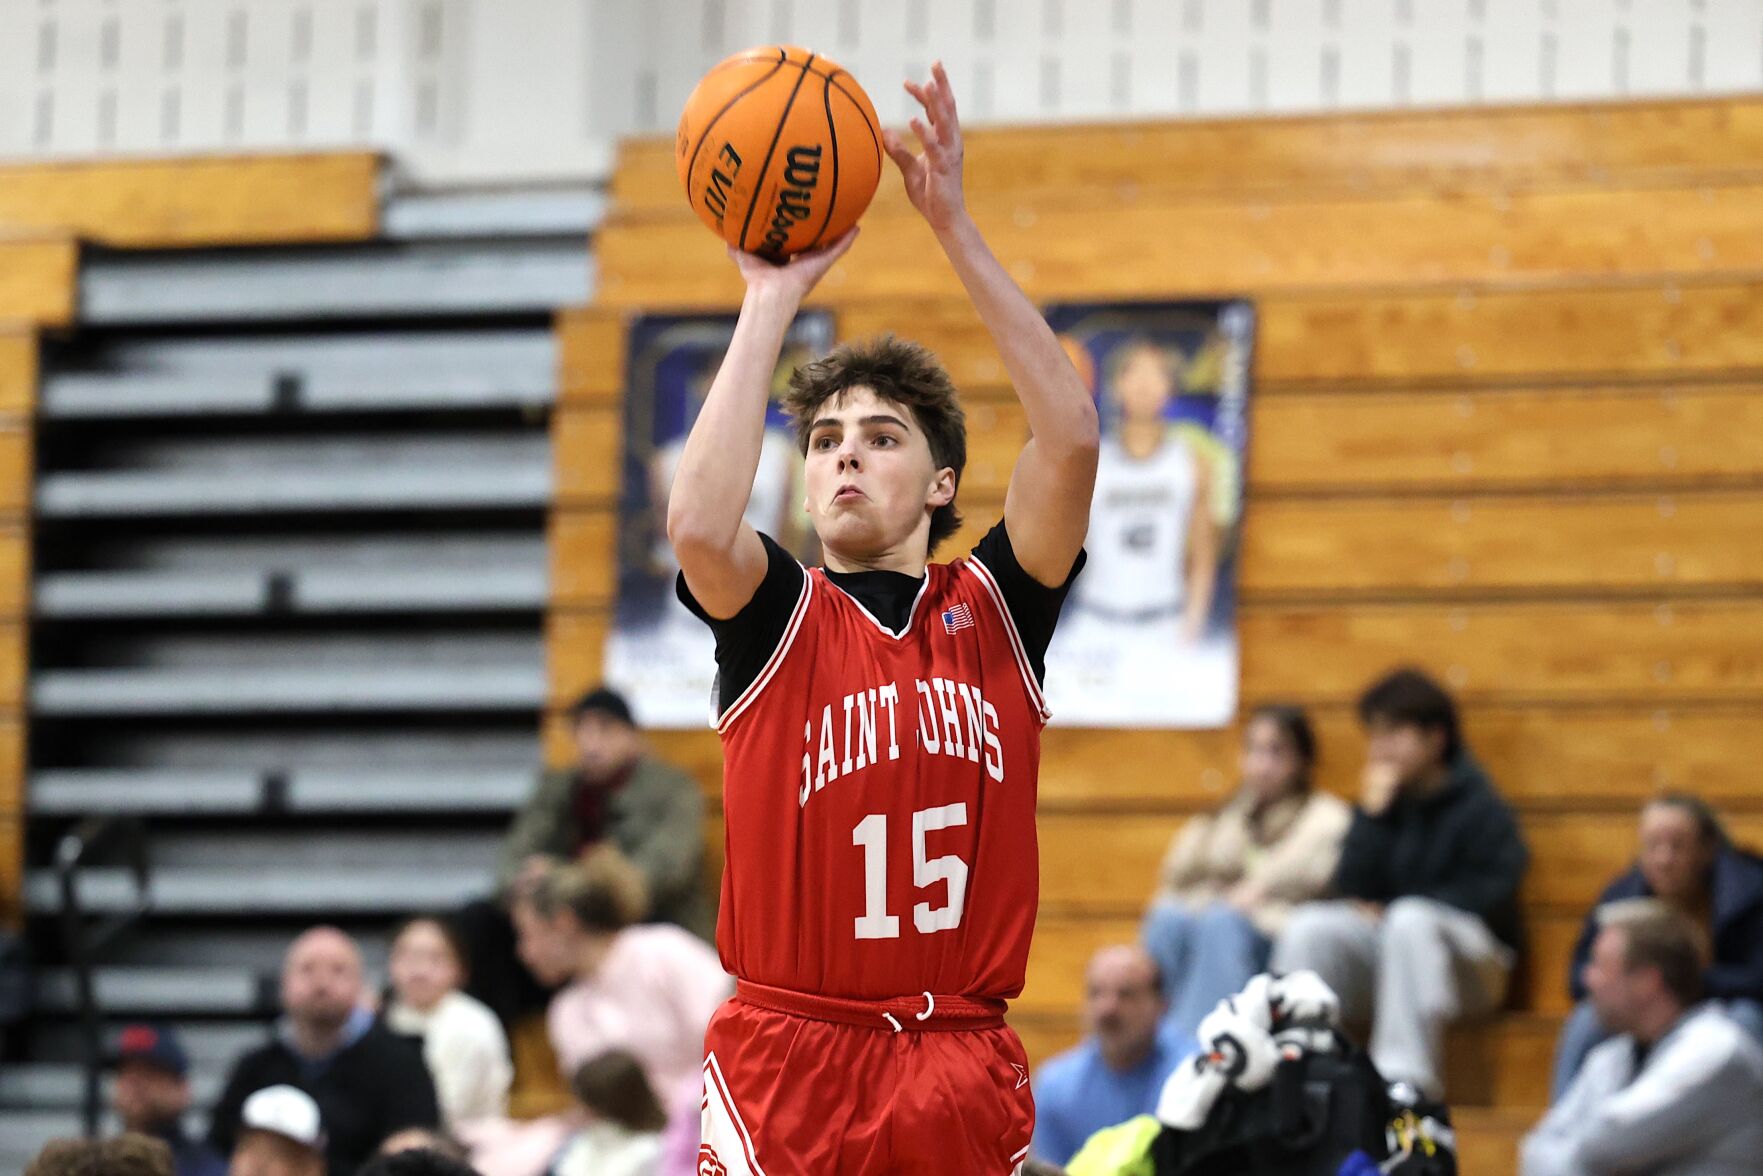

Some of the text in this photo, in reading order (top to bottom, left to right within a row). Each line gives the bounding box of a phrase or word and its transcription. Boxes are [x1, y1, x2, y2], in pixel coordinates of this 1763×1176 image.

[758, 144, 822, 252] Wilso
[799, 681, 900, 808] SAINT
[852, 802, 969, 940] 15
